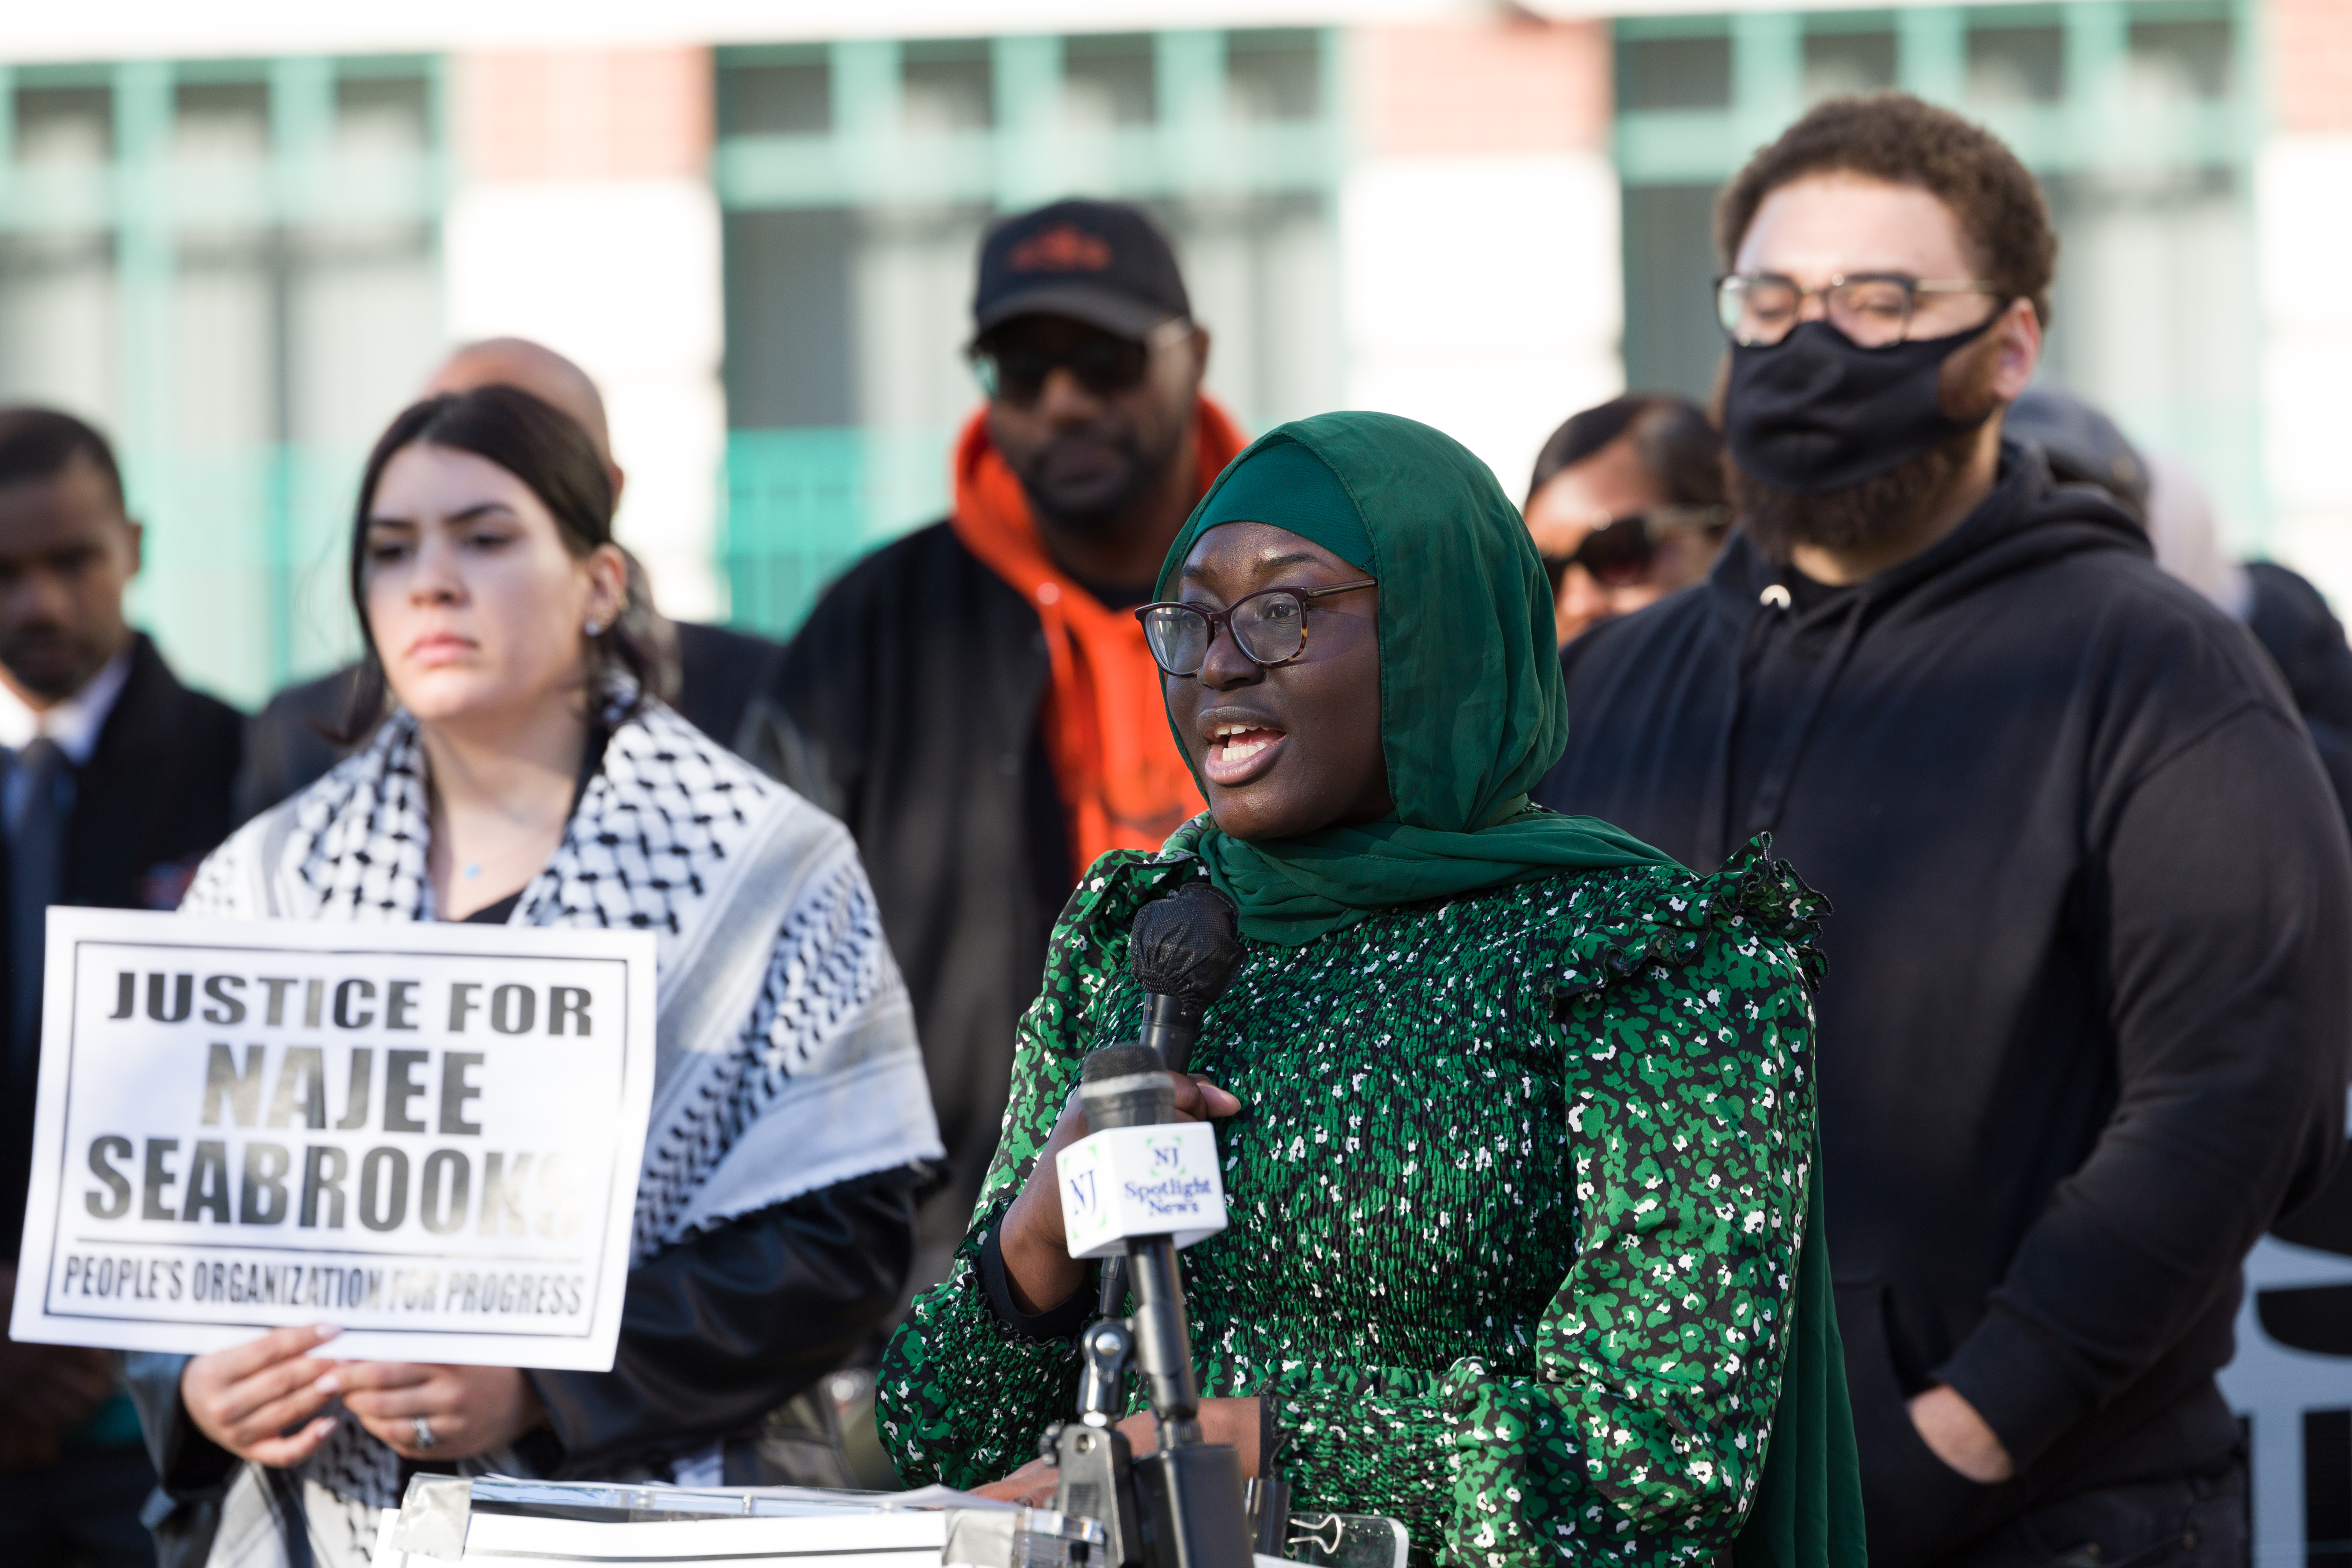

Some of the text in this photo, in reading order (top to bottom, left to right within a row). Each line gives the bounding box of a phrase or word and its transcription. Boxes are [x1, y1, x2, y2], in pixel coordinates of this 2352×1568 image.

[108, 971, 592, 1037] JUSTICE FOR
[200, 1043, 485, 1136] NAJEE
[1153, 1146, 1178, 1168] NJ
[85, 1135, 586, 1240] SEABROOKS
[1070, 1169, 1096, 1215] NJ
[1124, 1177, 1212, 1203] Spotlight
[1149, 1199, 1199, 1216] News
[63, 1255, 585, 1315] PEOPLE'S ORGANIZATION FOR PROGRESS
